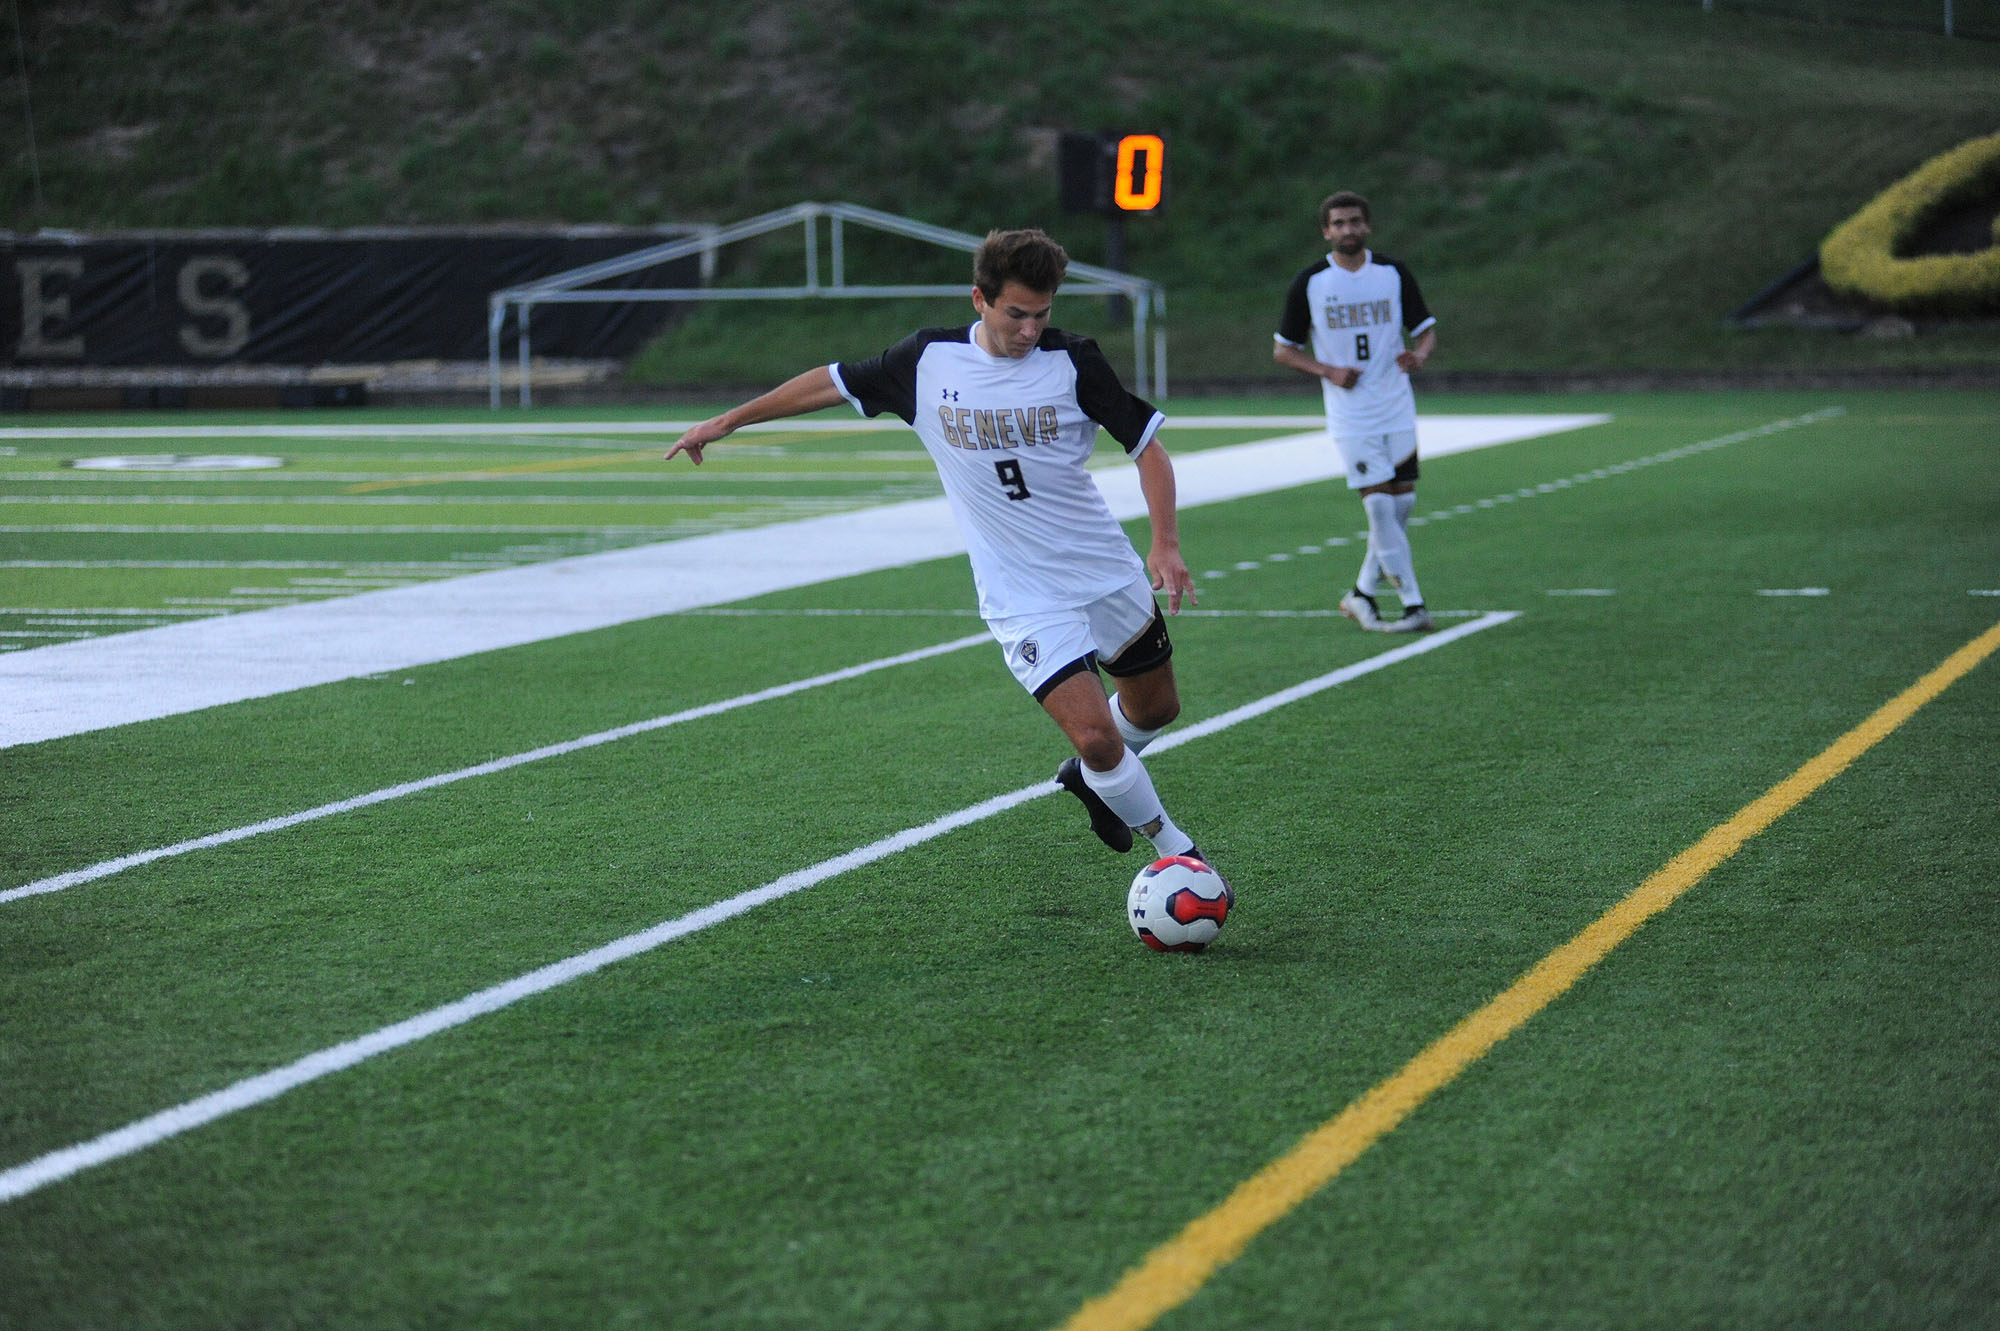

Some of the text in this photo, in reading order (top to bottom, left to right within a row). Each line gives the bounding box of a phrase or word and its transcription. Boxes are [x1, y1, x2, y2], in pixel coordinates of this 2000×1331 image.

[1114, 134, 1165, 211] 0
[1325, 299, 1392, 328] GENEVA
[1356, 334, 1370, 361] 8
[938, 405, 1060, 451] GENEVA
[994, 458, 1032, 501] 9
